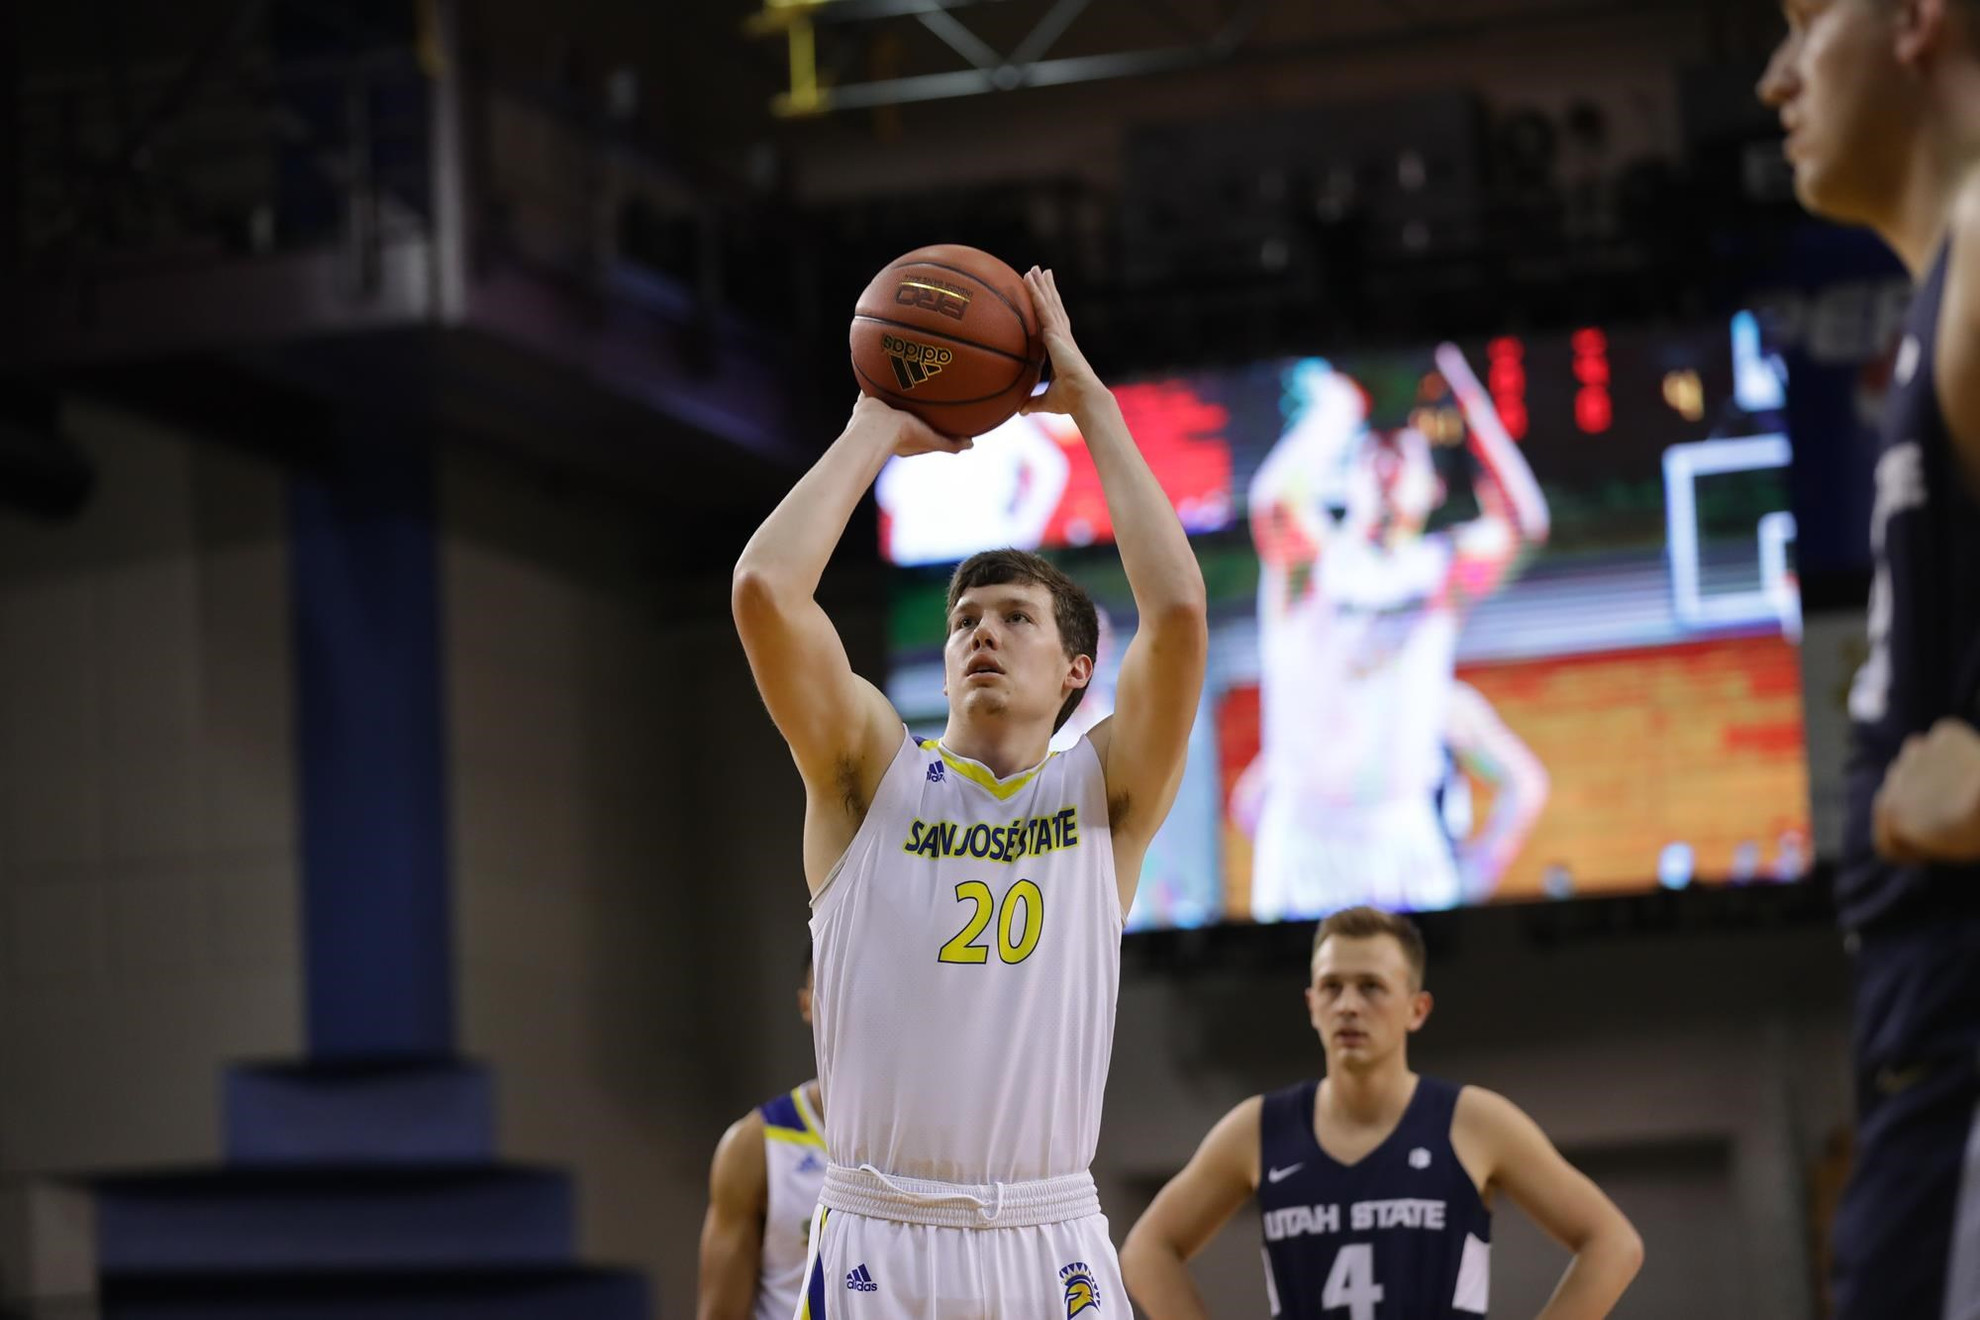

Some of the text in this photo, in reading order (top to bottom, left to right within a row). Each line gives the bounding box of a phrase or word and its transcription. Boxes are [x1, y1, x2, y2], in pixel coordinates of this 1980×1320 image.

[896, 284, 968, 320] PRO
[882, 334, 953, 365] adidas
[904, 806, 1080, 864] SAN JOSÉ STATE
[937, 878, 1045, 965] 20
[1264, 1198, 1447, 1241] UTAH STATE
[846, 1279, 878, 1292] didas
[1321, 1242, 1385, 1320] 4
